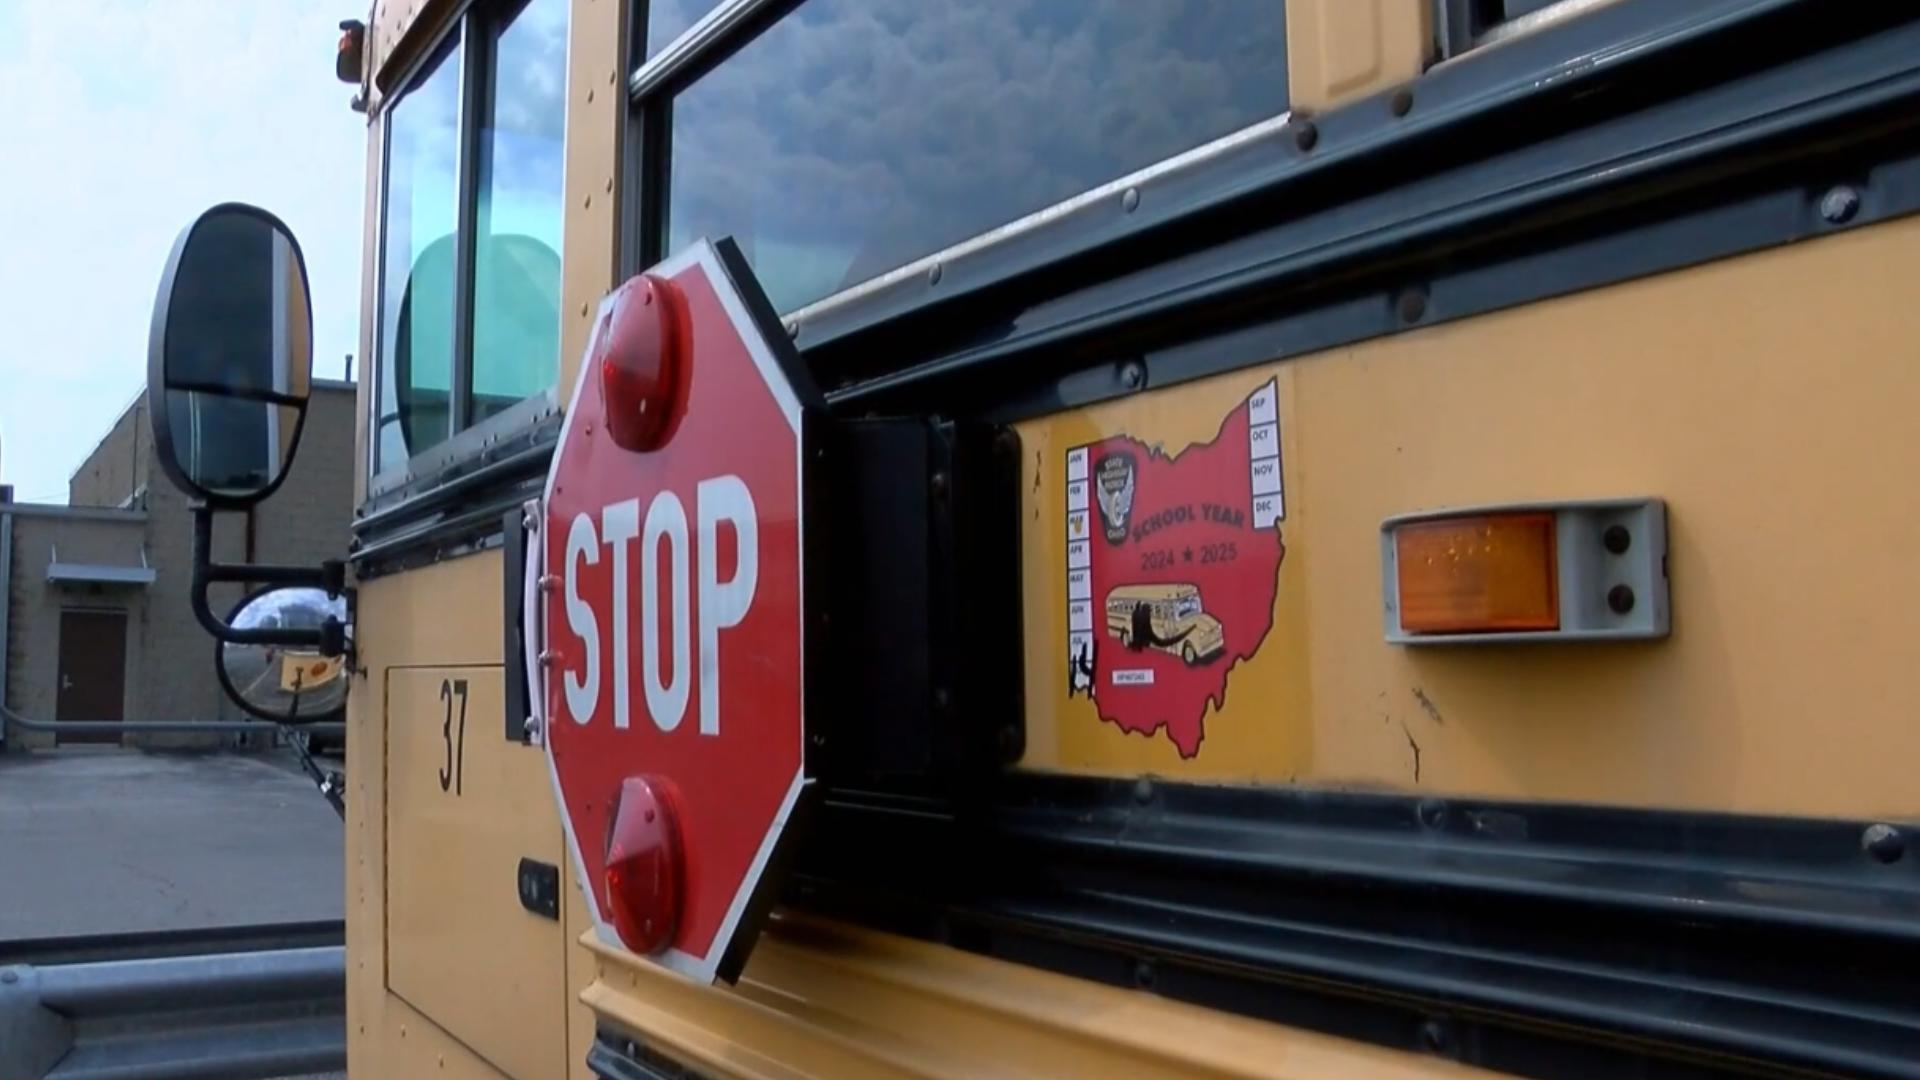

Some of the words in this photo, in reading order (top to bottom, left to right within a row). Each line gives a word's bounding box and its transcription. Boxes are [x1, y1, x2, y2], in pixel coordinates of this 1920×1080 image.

[1252, 399, 1265, 408] SEP
[1253, 430, 1268, 440] OCT
[1254, 465, 1273, 475] NOV
[1256, 501, 1272, 511] DEC
[1133, 504, 1196, 542] SCHOOL
[1202, 504, 1244, 528] YEAR
[1141, 549, 1175, 570] 2024
[1200, 542, 1238, 564] 2025
[564, 474, 758, 736] STOP
[440, 678, 468, 796] 37
